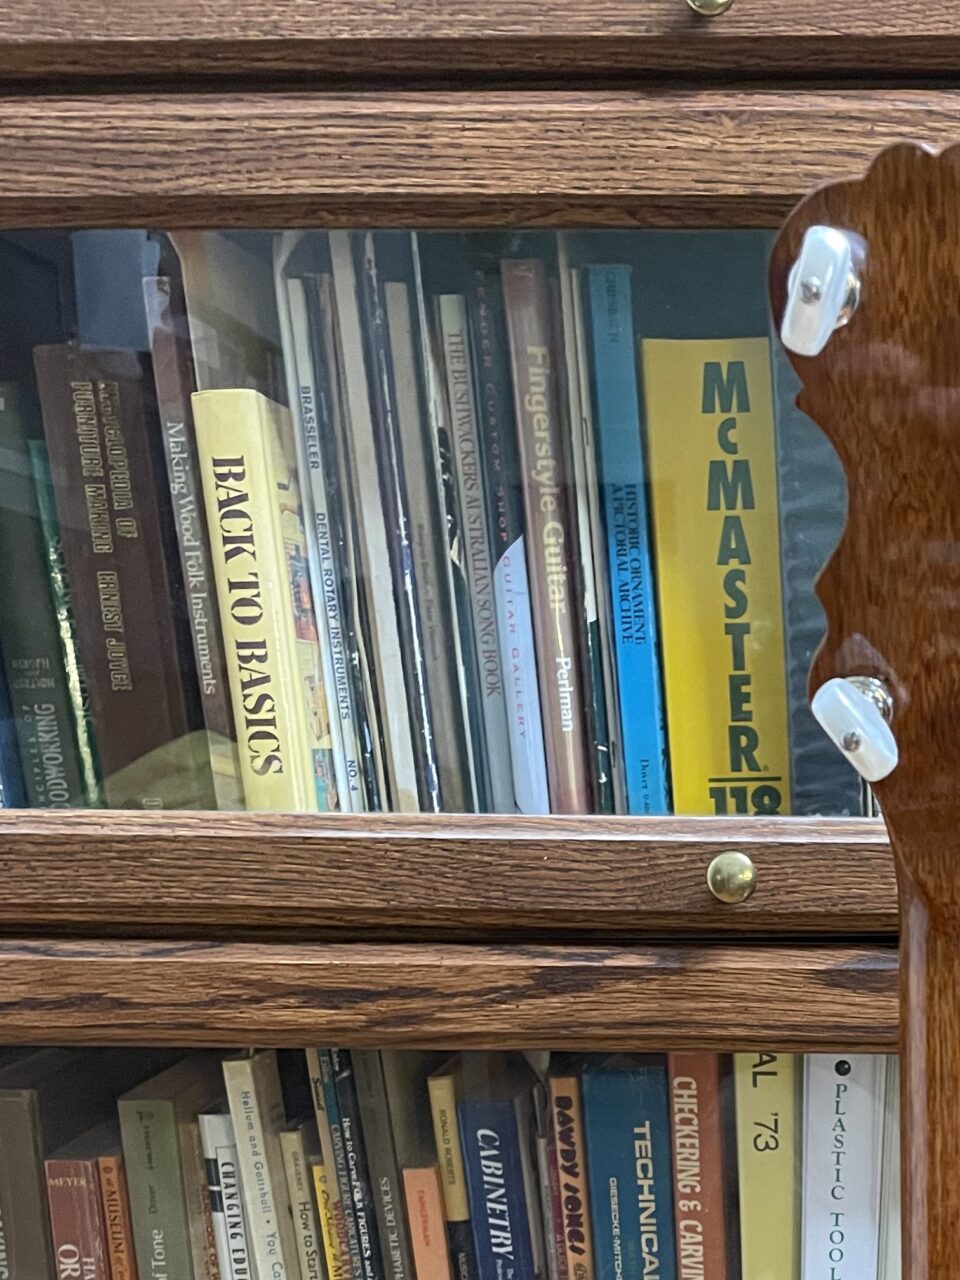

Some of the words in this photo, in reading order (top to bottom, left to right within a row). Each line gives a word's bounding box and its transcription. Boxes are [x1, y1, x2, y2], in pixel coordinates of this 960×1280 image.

[448, 331, 465, 366] THE
[71, 381, 104, 477] FURNITURE
[166, 421, 189, 495] Making
[301, 386, 320, 470] BRASSELER
[452, 370, 479, 491] BUSHWACKERS
[85, 484, 114, 553] MAKING
[177, 496, 200, 546] Wood
[212, 455, 258, 564] BACK
[316, 512, 332, 564] DENTAL
[525, 345, 557, 512] Fingerstyle
[542, 519, 567, 615] Guitar
[556, 656, 573, 733] Perlman
[613, 496, 629, 577] PICTORIAL
[624, 484, 641, 556] HISTORIC
[183, 546, 206, 590] Folk
[465, 496, 490, 595] AUSTRALIAN
[97, 571, 124, 633] ERNEST
[227, 571, 264, 626] TO
[323, 568, 340, 624] ROTARY
[478, 599, 495, 645] SONG
[618, 580, 634, 644] ARCHIVE
[106, 638, 133, 691] JOYCE
[190, 592, 217, 695] Instruments
[329, 627, 350, 721] INSTRUMENTS
[482, 649, 501, 697] BOOK
[501, 556, 516, 633] GUITAR
[512, 648, 526, 738] GALLERY
[235, 639, 284, 776] BASICS
[241, 1090, 255, 1131] Hellum
[555, 1095, 580, 1179] BAWDY
[673, 1076, 702, 1194] CHECKERING
[753, 1112, 779, 1153] '73
[831, 1083, 848, 1200] PLASTIC
[249, 1136, 262, 1157] and
[439, 1109, 451, 1145] RONALD
[445, 1147, 456, 1186] ROBERTS
[48, 1177, 87, 1188] MEYER
[221, 1162, 243, 1240] CHANGING
[254, 1161, 272, 1214] Gottshall
[380, 1177, 396, 1226] DEVICES
[476, 1128, 514, 1260] CABINETRY
[678, 1200, 702, 1212] &
[107, 1190, 125, 1254] MUSEUM
[266, 1232, 279, 1256] You
[299, 1201, 312, 1232] How
[303, 1234, 314, 1248] to
[562, 1183, 586, 1256] SONGS
[151, 1229, 168, 1270] Tone
